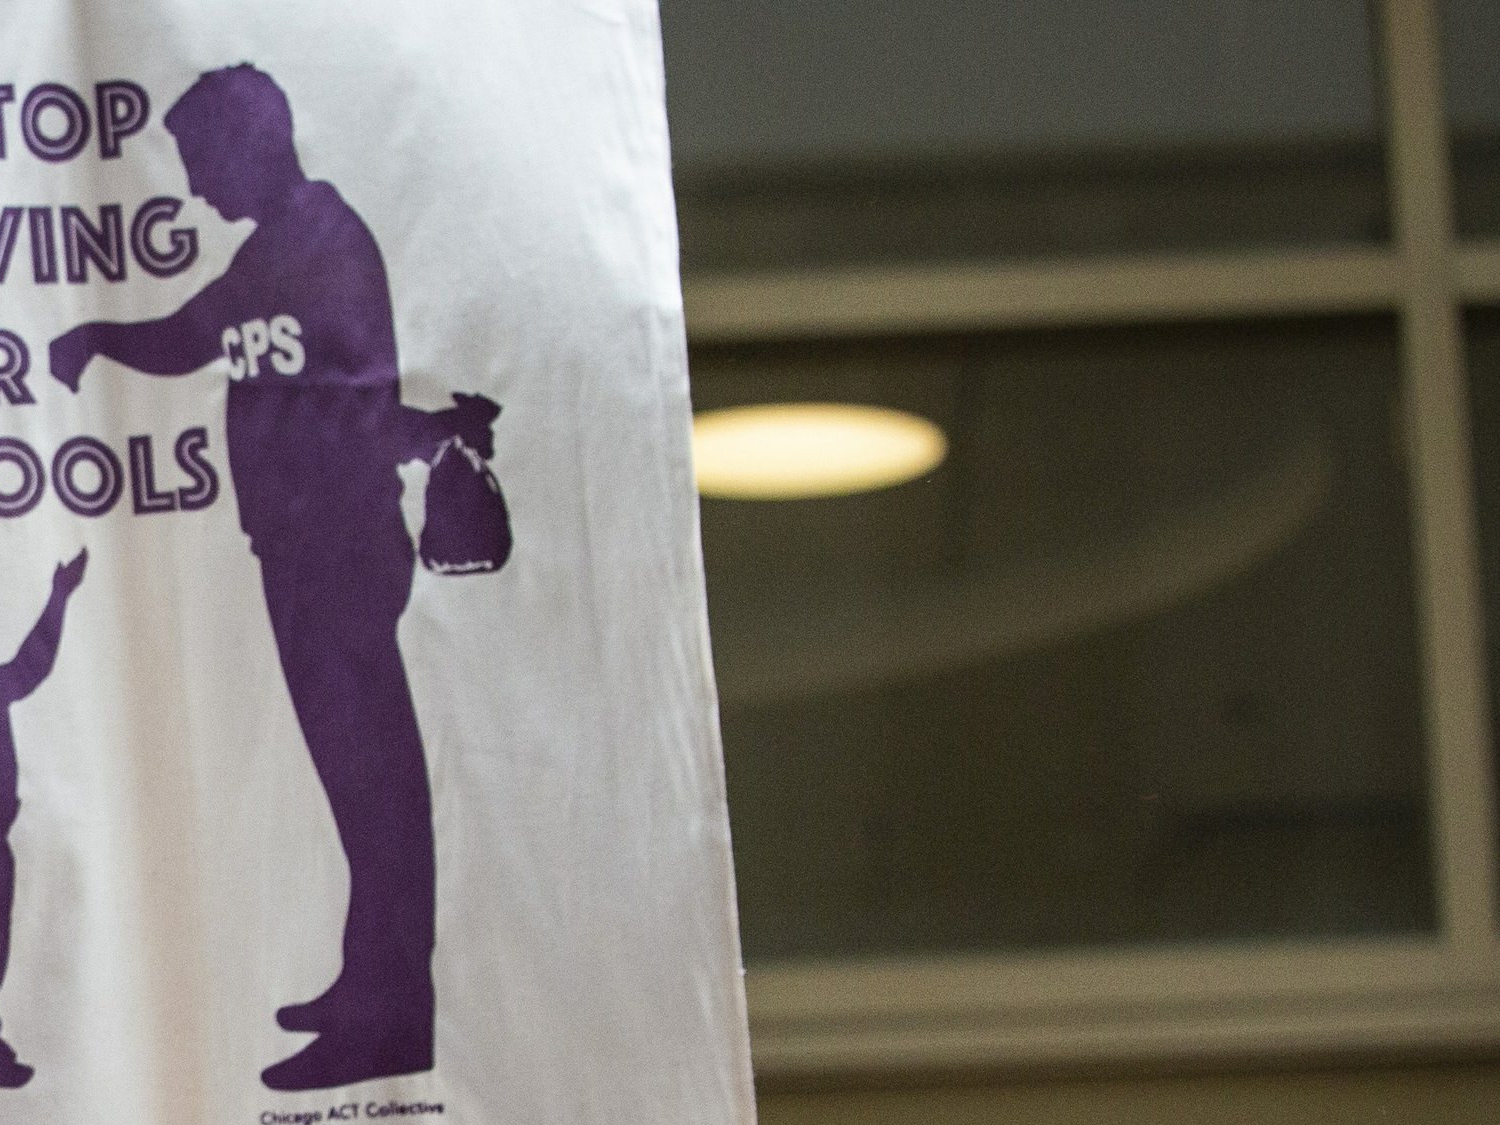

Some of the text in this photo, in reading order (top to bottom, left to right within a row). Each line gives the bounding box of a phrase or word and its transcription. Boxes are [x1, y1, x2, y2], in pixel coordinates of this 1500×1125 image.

[222, 314, 305, 382] CPS
[327, 1103, 360, 1121] ACT
[365, 1101, 445, 1119] Collective
